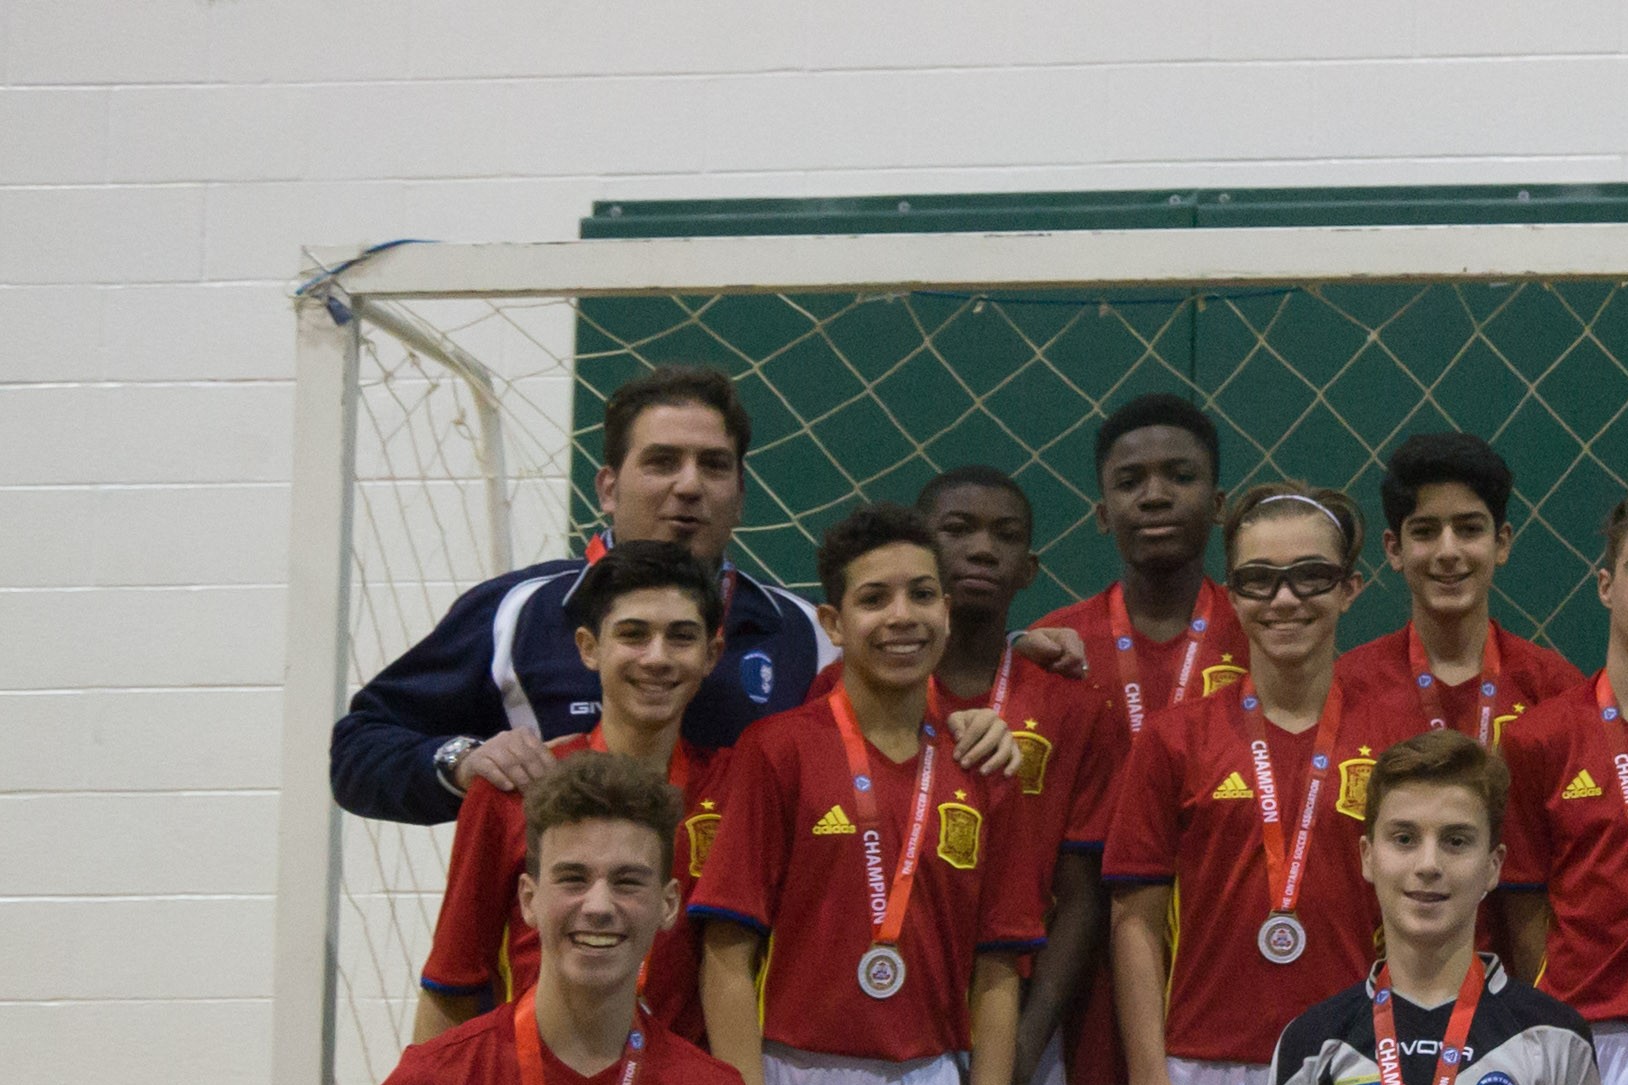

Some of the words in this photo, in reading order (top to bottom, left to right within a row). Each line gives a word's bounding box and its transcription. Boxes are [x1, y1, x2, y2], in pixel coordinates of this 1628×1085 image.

[1125, 682, 1145, 732] CHAM
[1251, 739, 1278, 823] CHAMPION
[1562, 786, 1602, 800] adidas
[812, 824, 856, 835] adidas
[863, 830, 887, 925] CHAMPION
